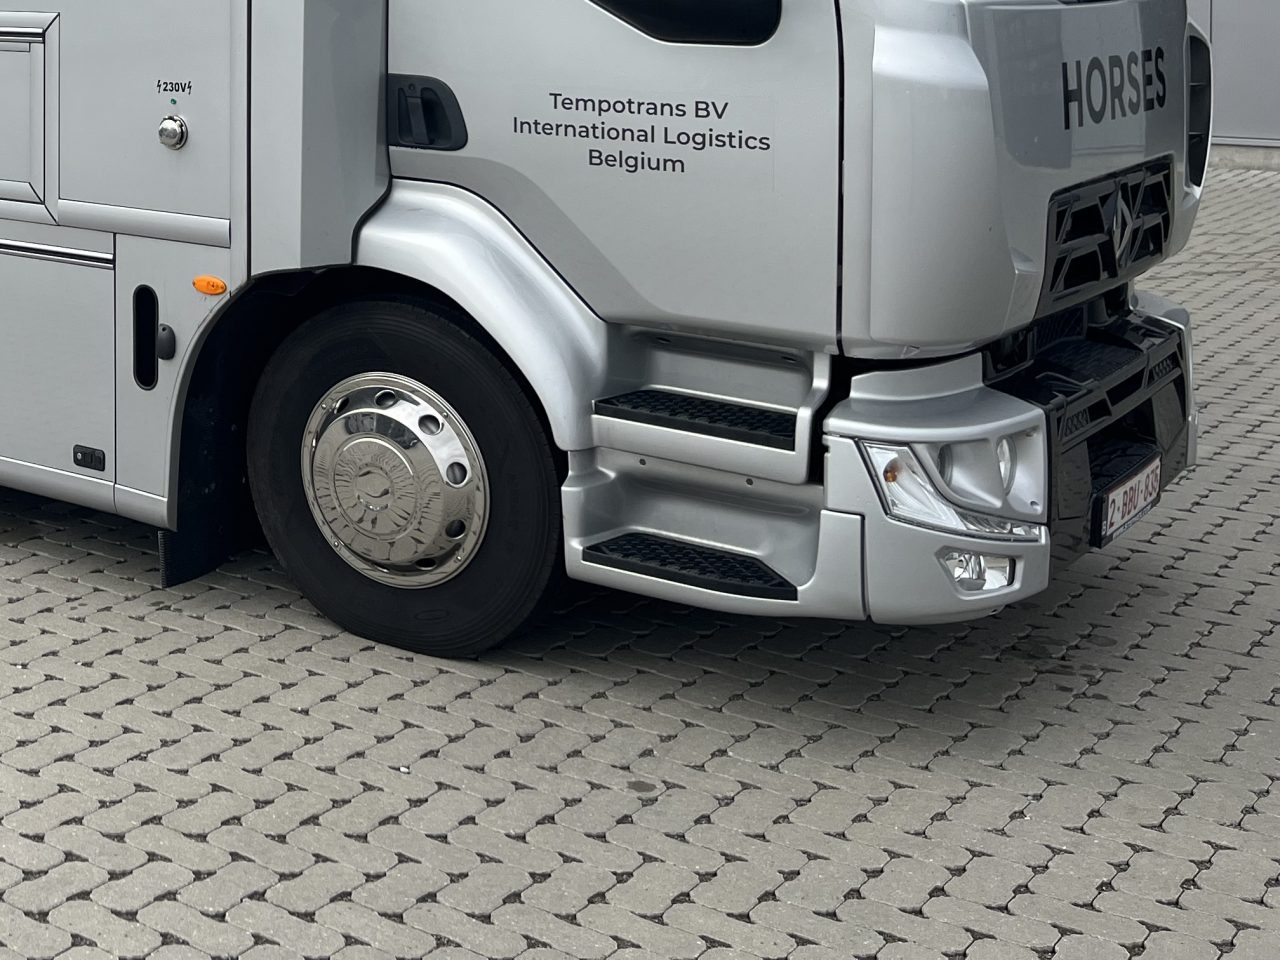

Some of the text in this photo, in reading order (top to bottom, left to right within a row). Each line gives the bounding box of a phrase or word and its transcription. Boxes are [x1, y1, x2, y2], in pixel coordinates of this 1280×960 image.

[162, 81, 187, 93] 230V
[1061, 46, 1167, 130] HORSES
[549, 92, 729, 120] Tempotrans BV
[513, 117, 771, 151] International Logistics
[588, 149, 685, 174] Belgium
